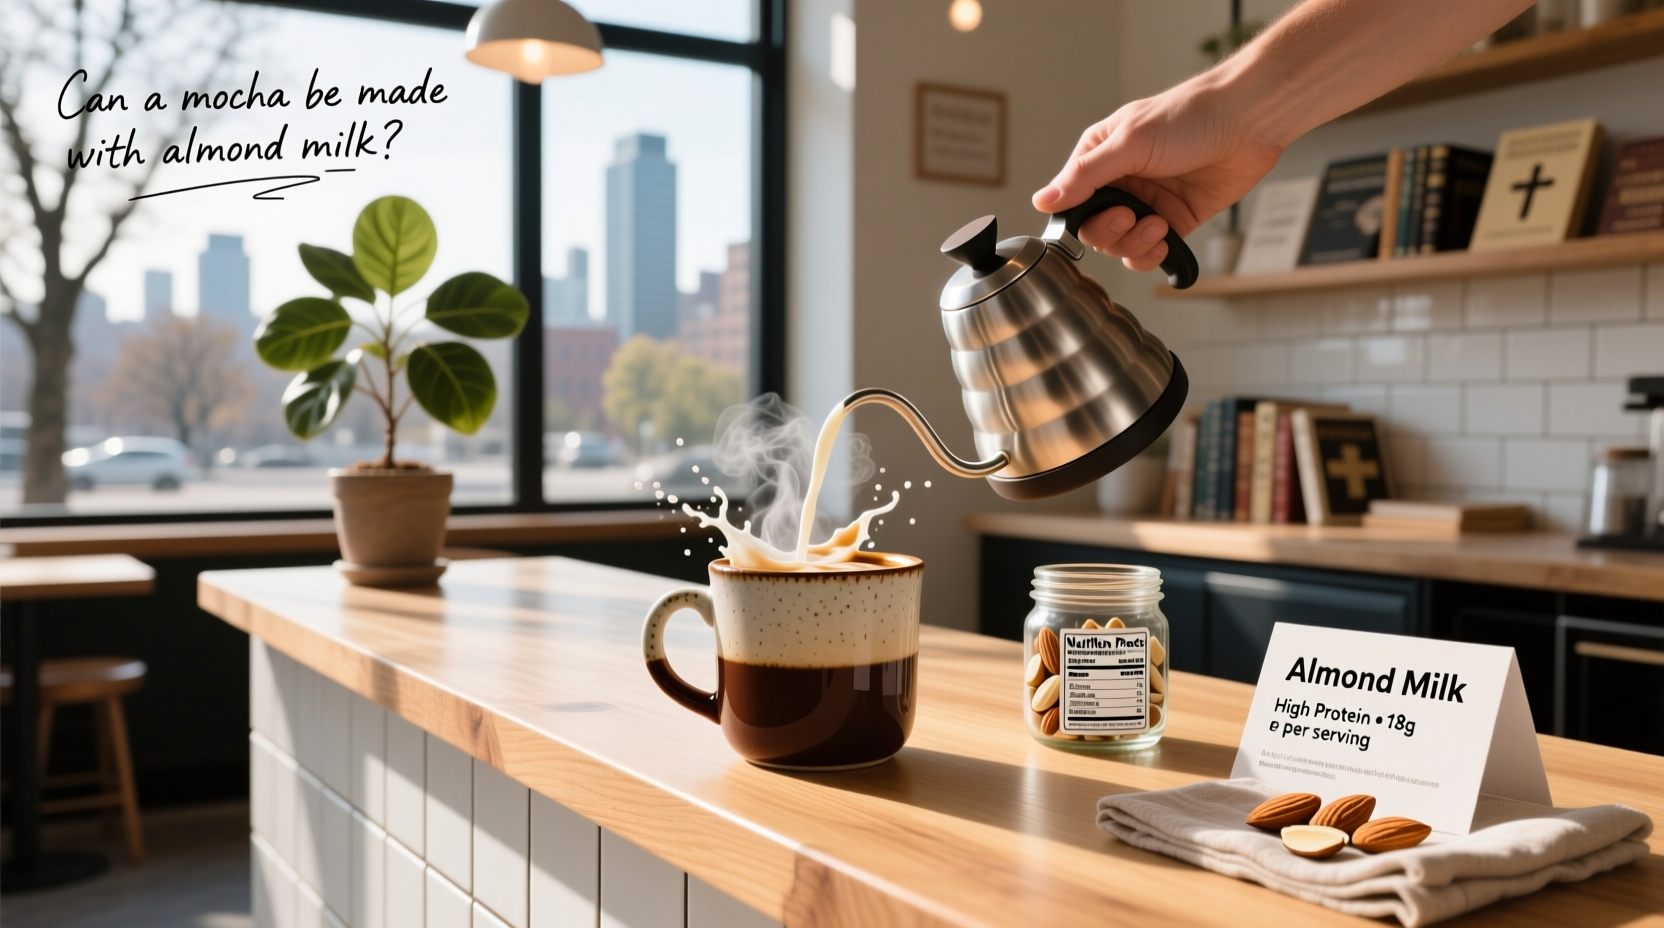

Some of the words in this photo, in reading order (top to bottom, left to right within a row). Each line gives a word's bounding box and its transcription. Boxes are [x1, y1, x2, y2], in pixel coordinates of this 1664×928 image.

[1285, 656, 1397, 694] Almond
[1401, 670, 1468, 703] Milk
[1274, 697, 1310, 719] High
[1314, 702, 1371, 725] Protein
[1387, 713, 1416, 737] 18g
[1282, 722, 1311, 738] per
[1312, 727, 1371, 752] serving
